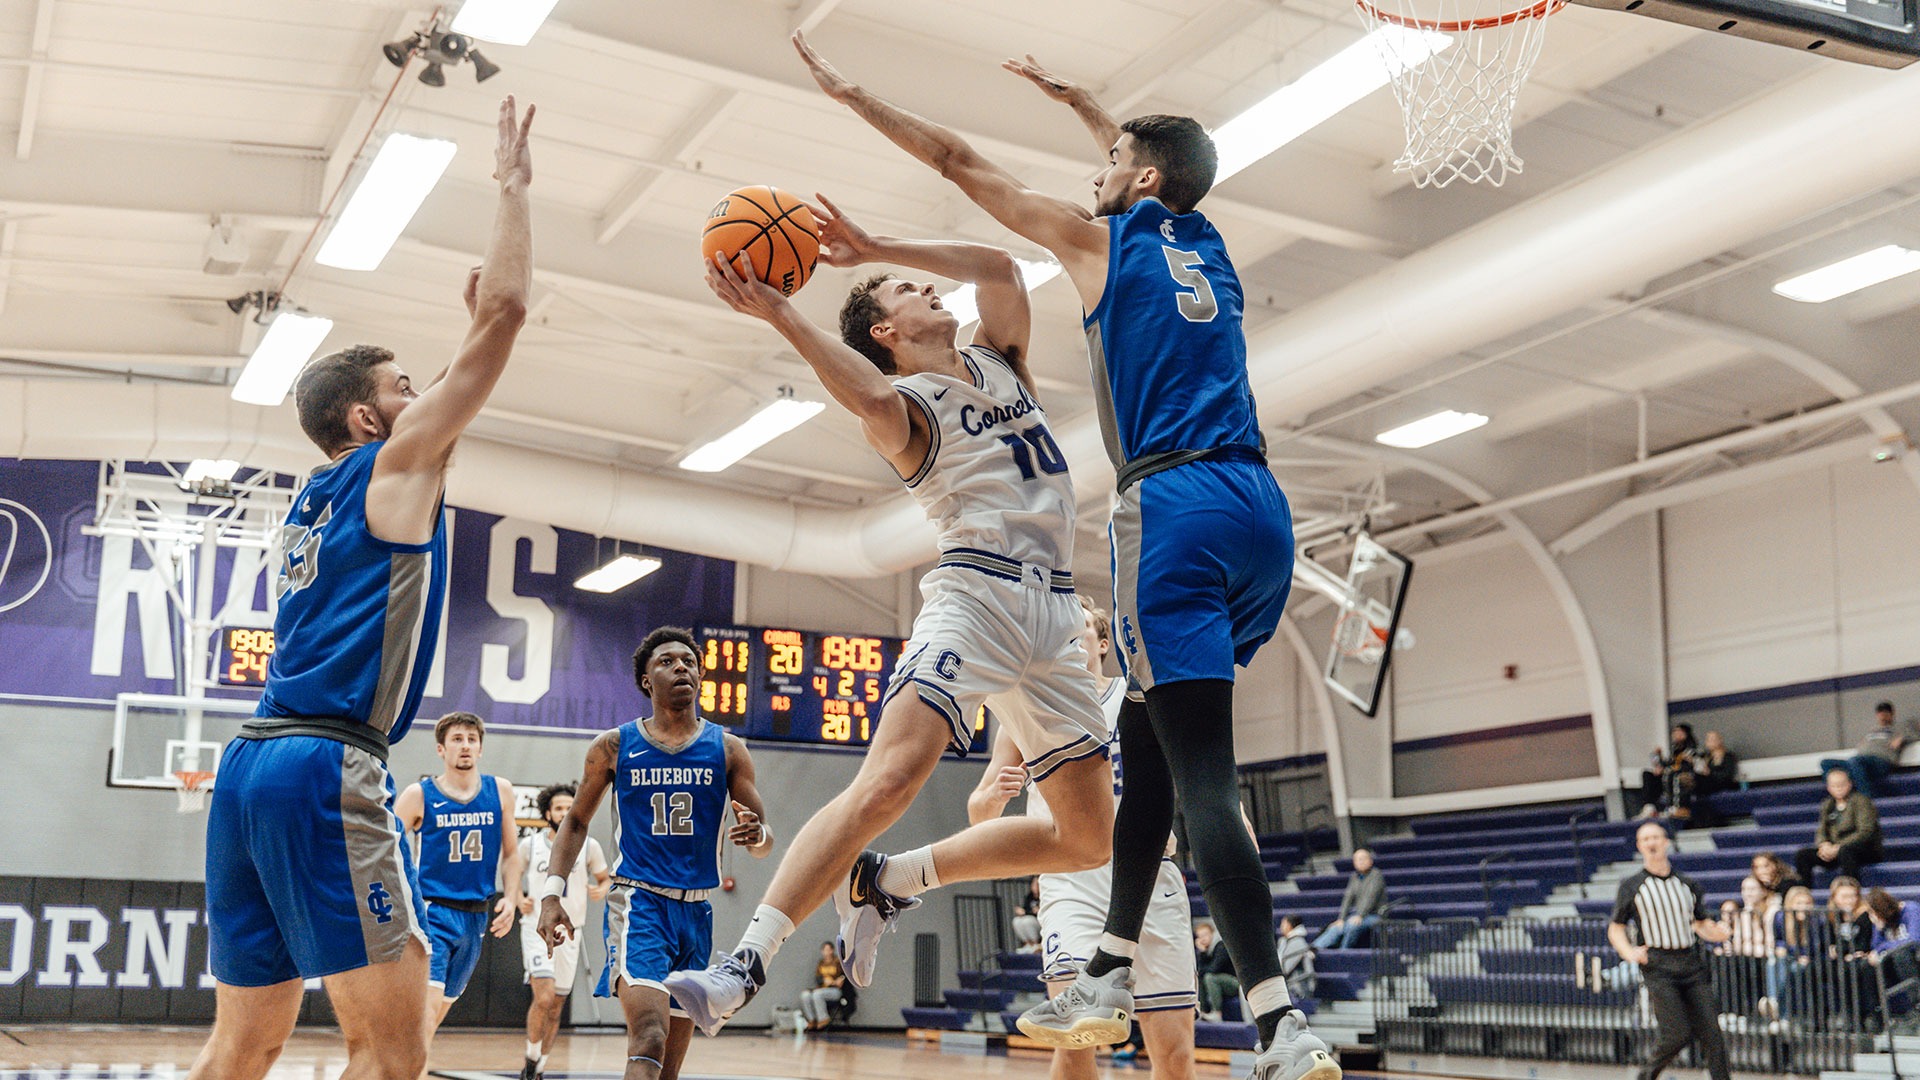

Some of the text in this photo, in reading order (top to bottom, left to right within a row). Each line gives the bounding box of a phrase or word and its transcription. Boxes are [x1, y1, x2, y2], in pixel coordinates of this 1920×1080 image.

[1161, 244, 1219, 322] 5
[997, 422, 1069, 482] 10
[230, 629, 276, 654] 19:06
[823, 636, 883, 672] 19:06
[228, 650, 268, 682] 24
[770, 643, 803, 675] 20
[932, 647, 964, 683] C
[813, 676, 828, 697] 4
[838, 670, 855, 696] 2
[865, 679, 879, 702] 5
[821, 713, 870, 741] 20 1
[630, 767, 713, 786] BLUEBOYS
[436, 811, 494, 828] BLUEBOYS
[650, 792, 694, 836] 12
[448, 829, 483, 863] 14
